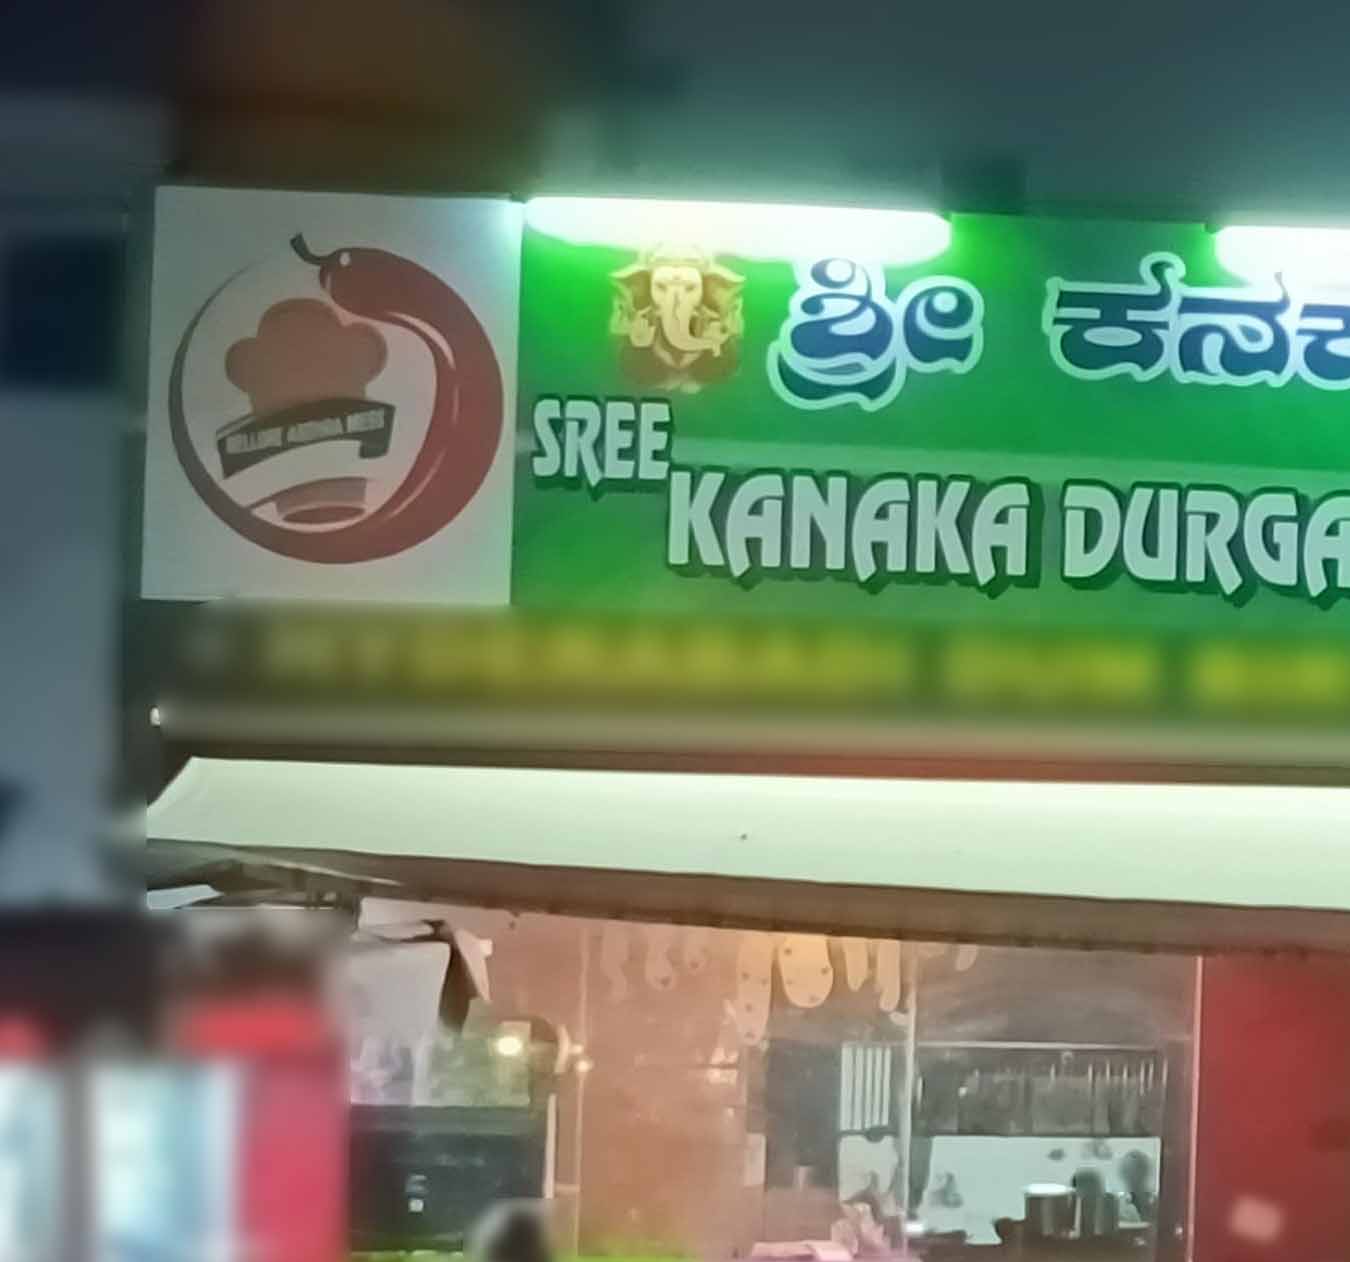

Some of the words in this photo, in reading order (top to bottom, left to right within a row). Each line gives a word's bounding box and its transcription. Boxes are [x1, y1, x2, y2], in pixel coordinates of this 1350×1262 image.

[768, 254, 983, 410] ಶ್ರೀ
[532, 398, 671, 486] SREE
[668, 470, 1031, 587] KANAKA
